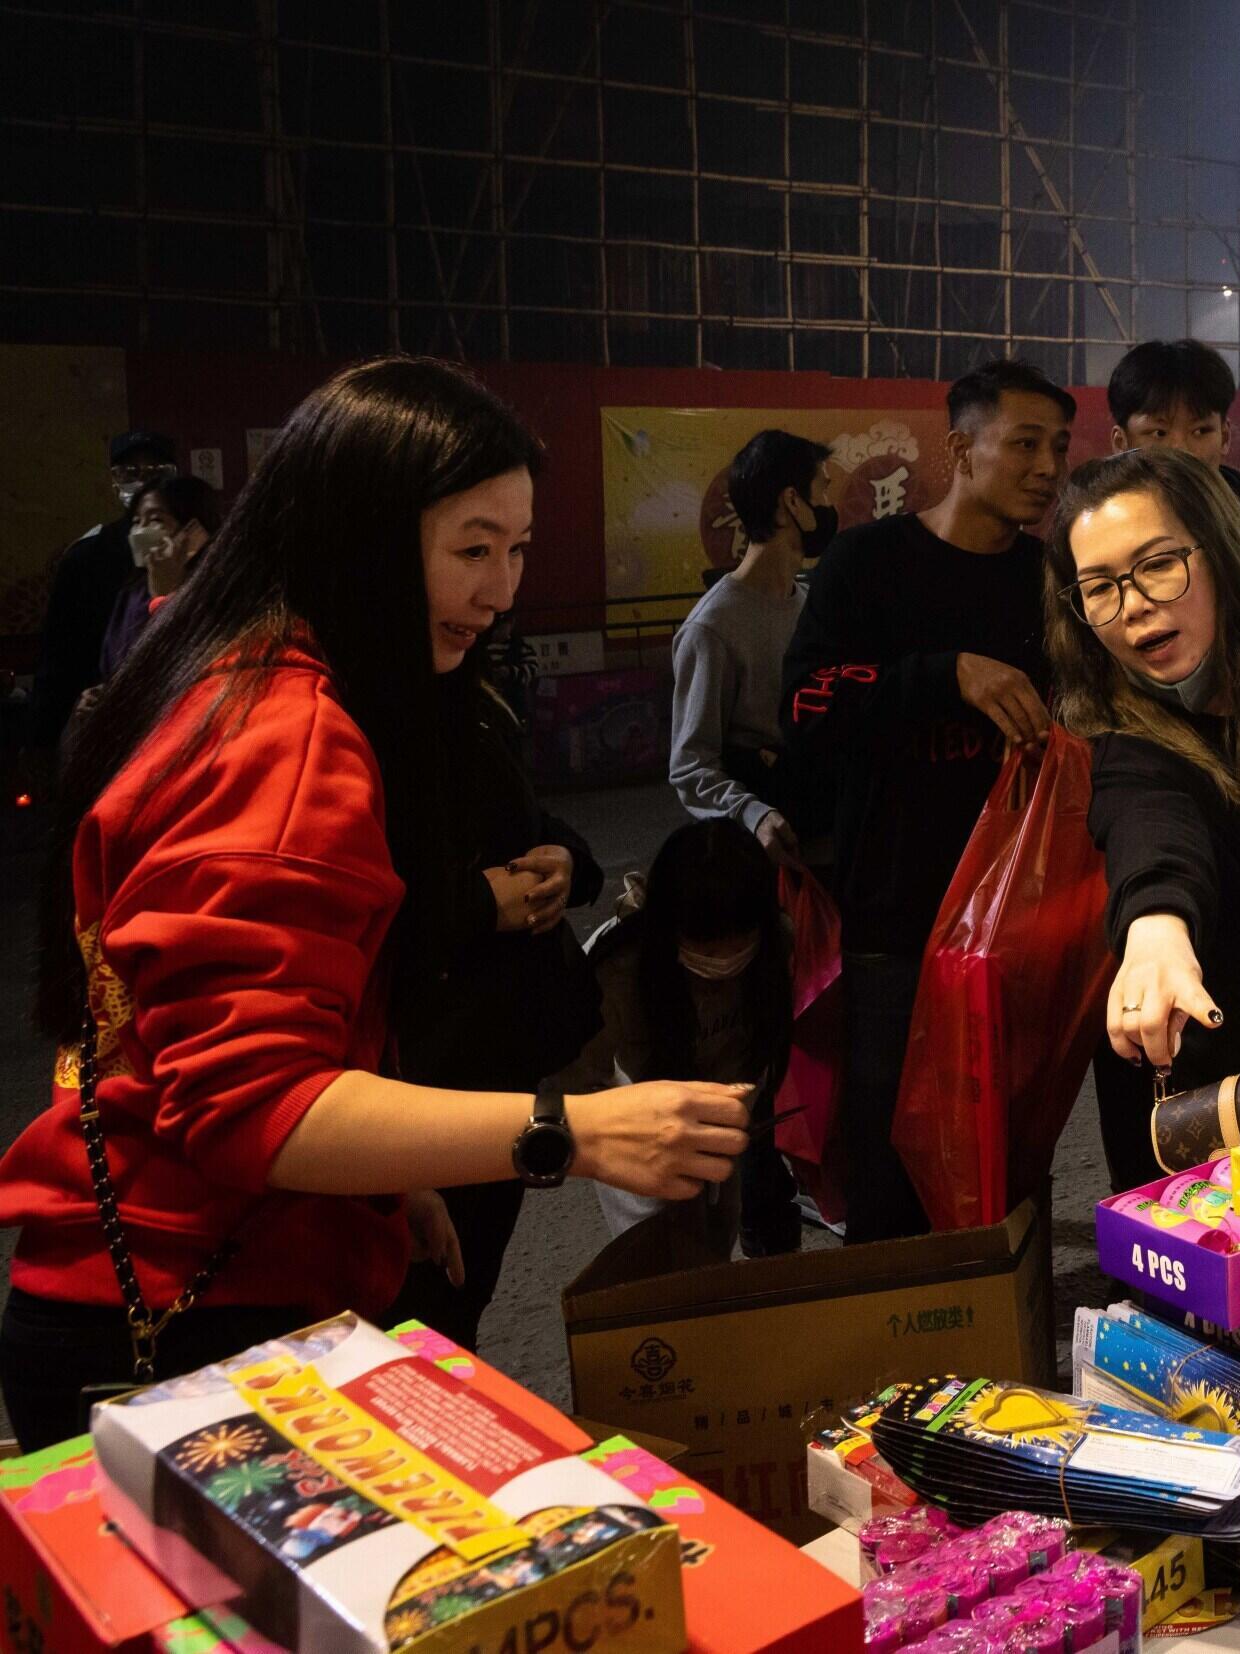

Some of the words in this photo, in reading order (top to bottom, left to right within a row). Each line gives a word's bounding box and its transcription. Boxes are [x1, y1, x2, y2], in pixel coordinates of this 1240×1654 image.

[1132, 1244, 1144, 1273] 4
[1148, 1250, 1187, 1291] PCS
[244, 1366, 487, 1542] FIREWORKS
[1149, 1551, 1187, 1603] 45
